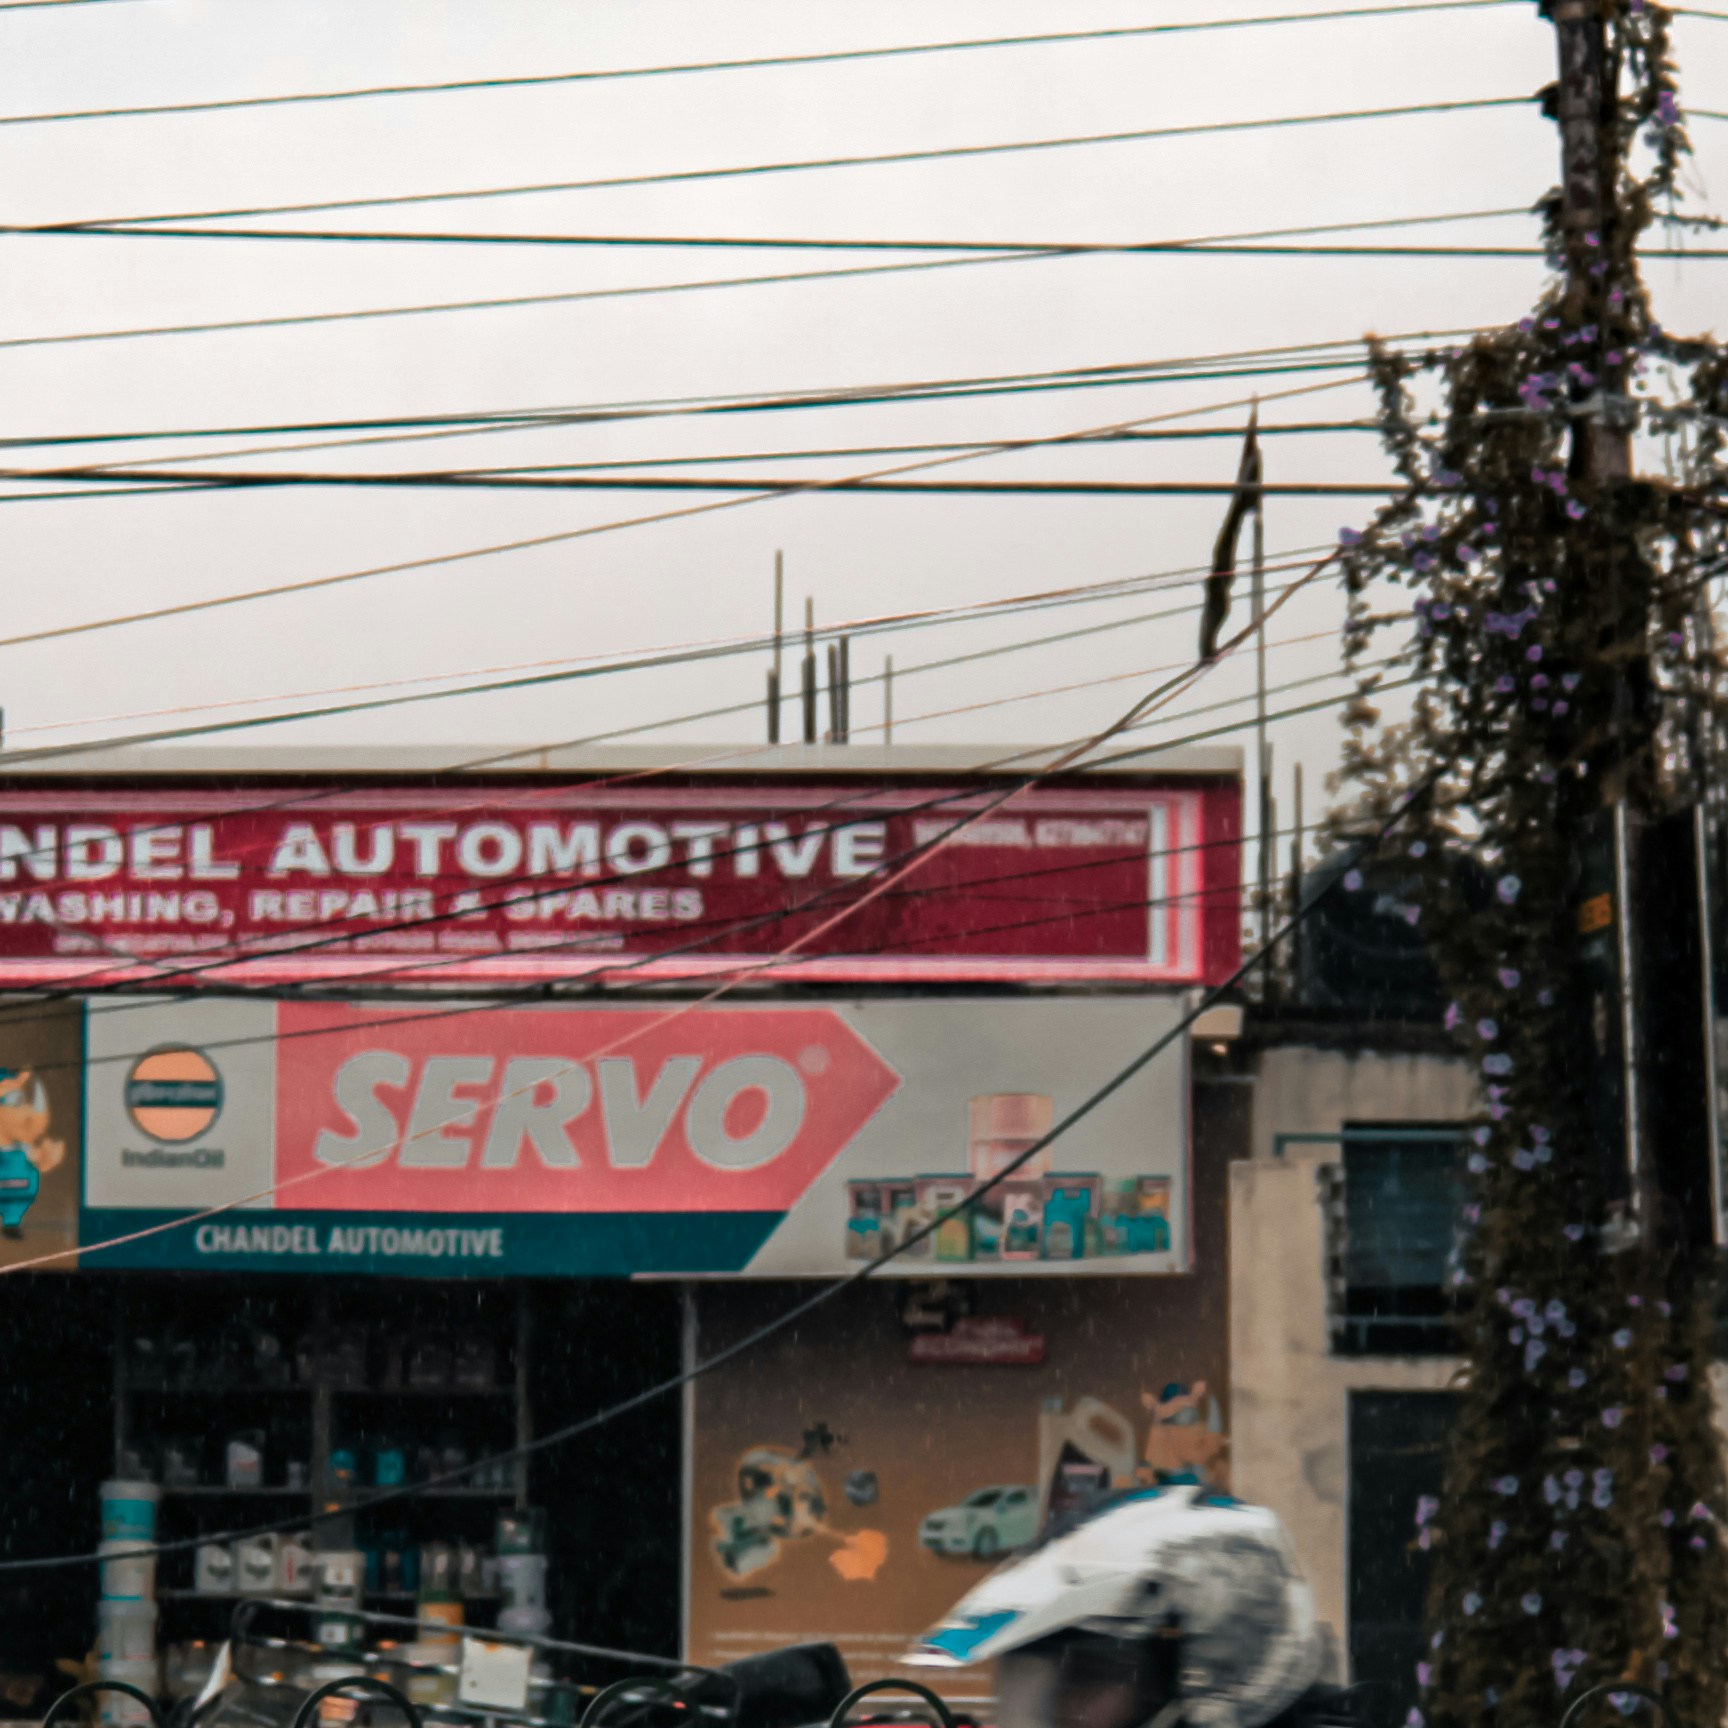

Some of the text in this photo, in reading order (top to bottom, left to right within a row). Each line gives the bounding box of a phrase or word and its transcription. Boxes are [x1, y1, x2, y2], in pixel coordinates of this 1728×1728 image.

[268, 820, 890, 878] AUTOMOTIVE
[249, 889, 434, 923] REPAIR
[446, 889, 489, 921] &
[503, 887, 704, 922] SPARES
[314, 1050, 807, 1171] SERVO
[195, 1225, 504, 1257] CHANDEL AUTOMOTIVE
